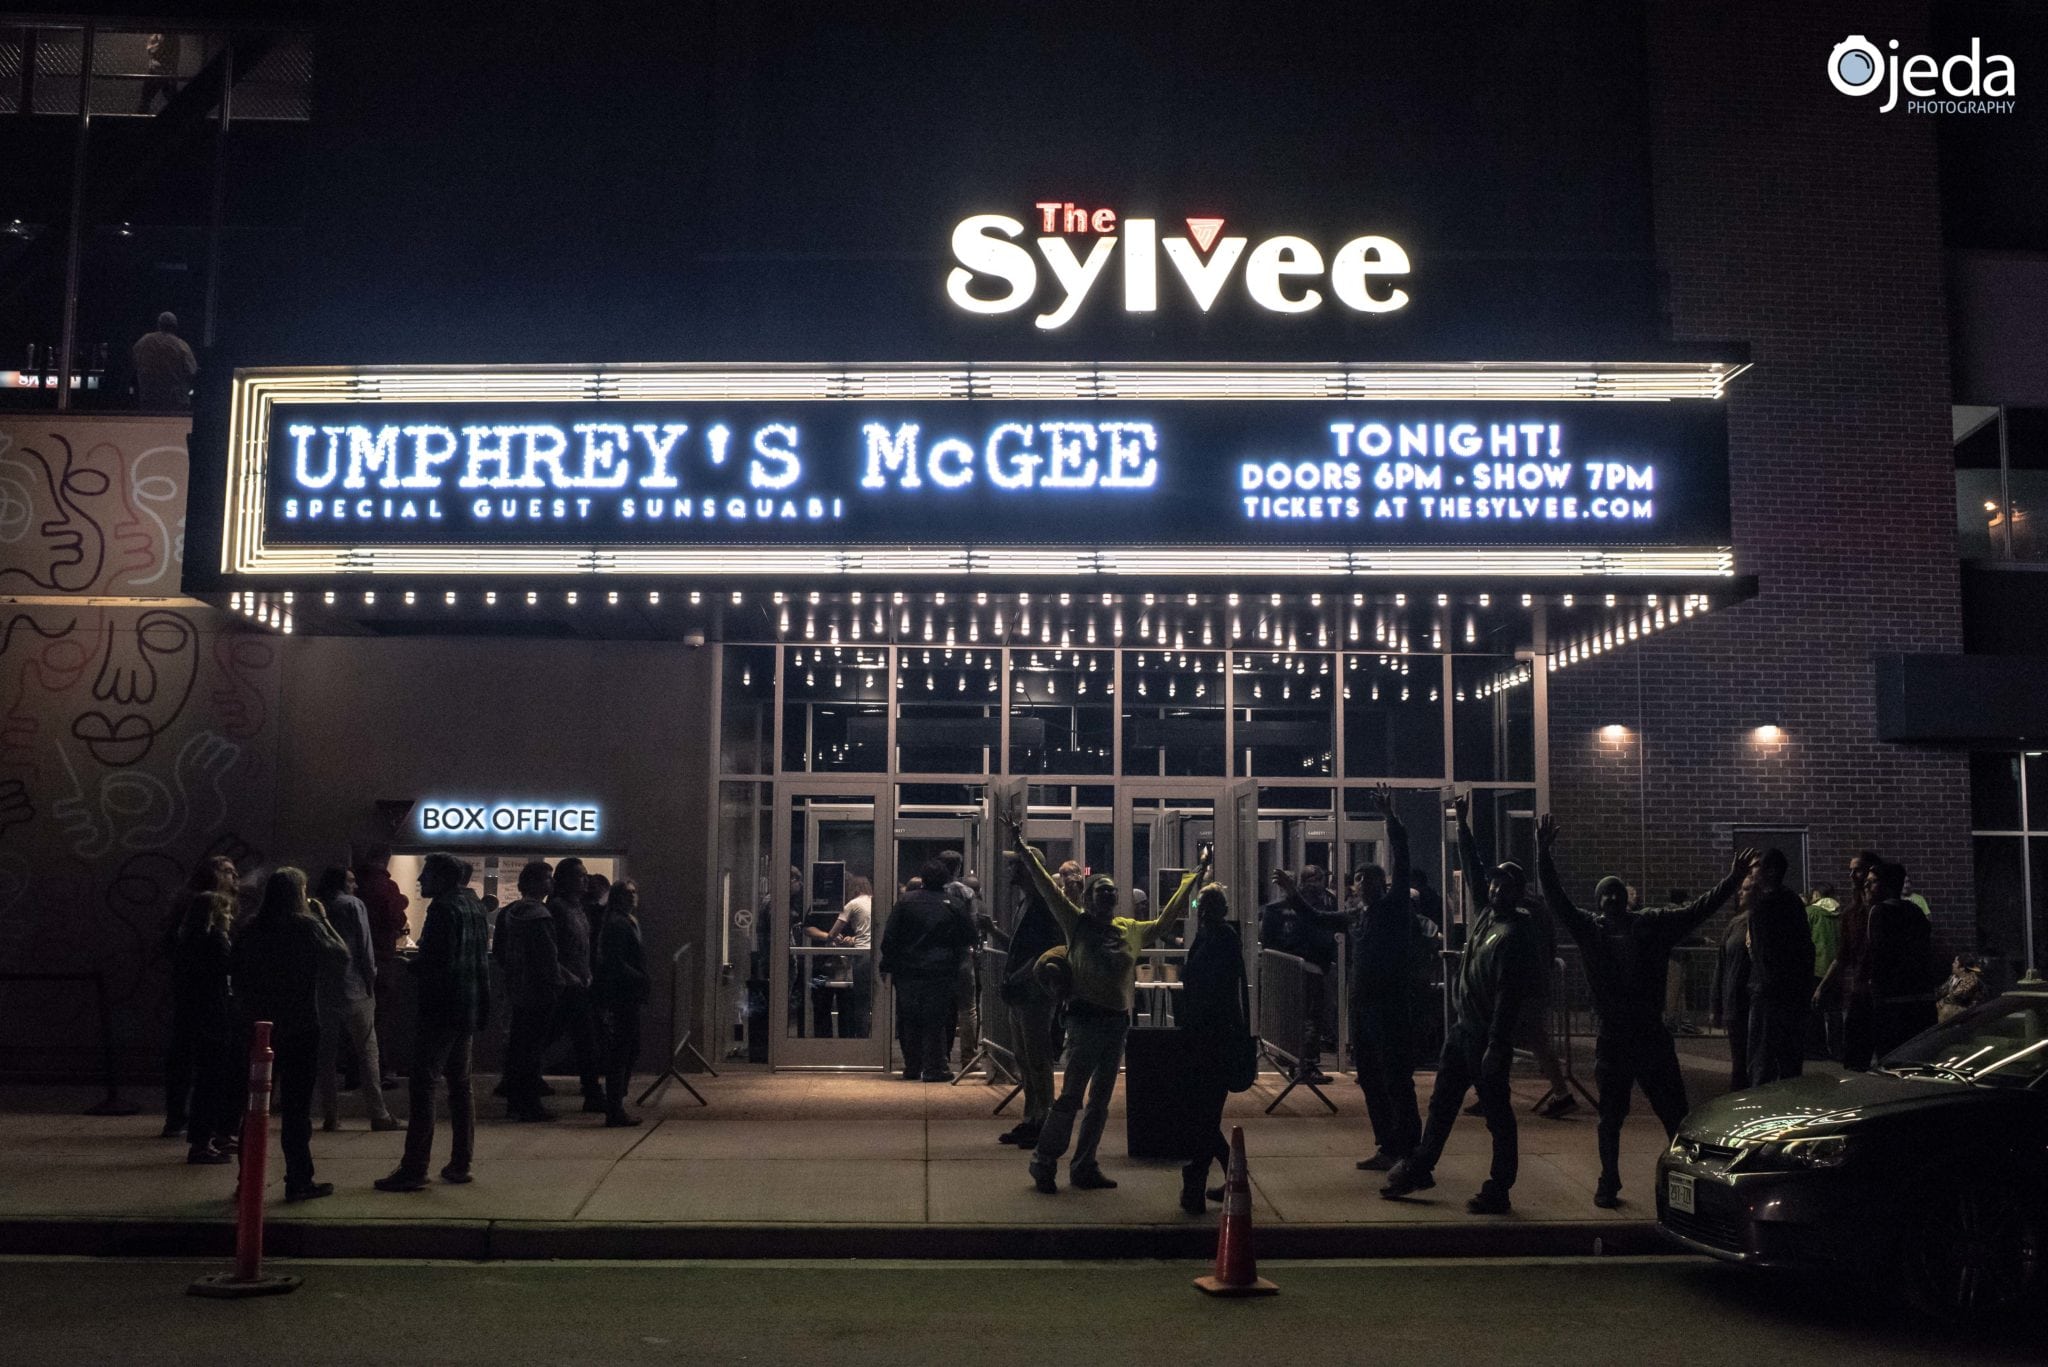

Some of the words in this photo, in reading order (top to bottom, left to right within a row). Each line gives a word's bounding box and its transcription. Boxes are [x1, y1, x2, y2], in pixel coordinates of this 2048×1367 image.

[1036, 202, 1116, 233] The
[946, 213, 1411, 329] Sylvee
[1330, 423, 1561, 458] TONIGHT!
[289, 423, 802, 490] UMPHREY'S
[861, 422, 1159, 490] McGEE
[1241, 462, 1361, 491] DOORS
[1374, 462, 1442, 491] 6PM
[1473, 463, 1572, 491] SHOW
[1586, 463, 1654, 491] 7PM
[286, 499, 442, 518] SPECIAL
[473, 499, 591, 518] GUEST
[622, 498, 842, 519] SUNSQUABI
[1243, 496, 1360, 519] TICKETS
[1374, 497, 1408, 519] AT
[1420, 496, 1653, 519] THESYLVEE.COM
[422, 807, 485, 830] BOX
[492, 808, 598, 832] OFFICE
